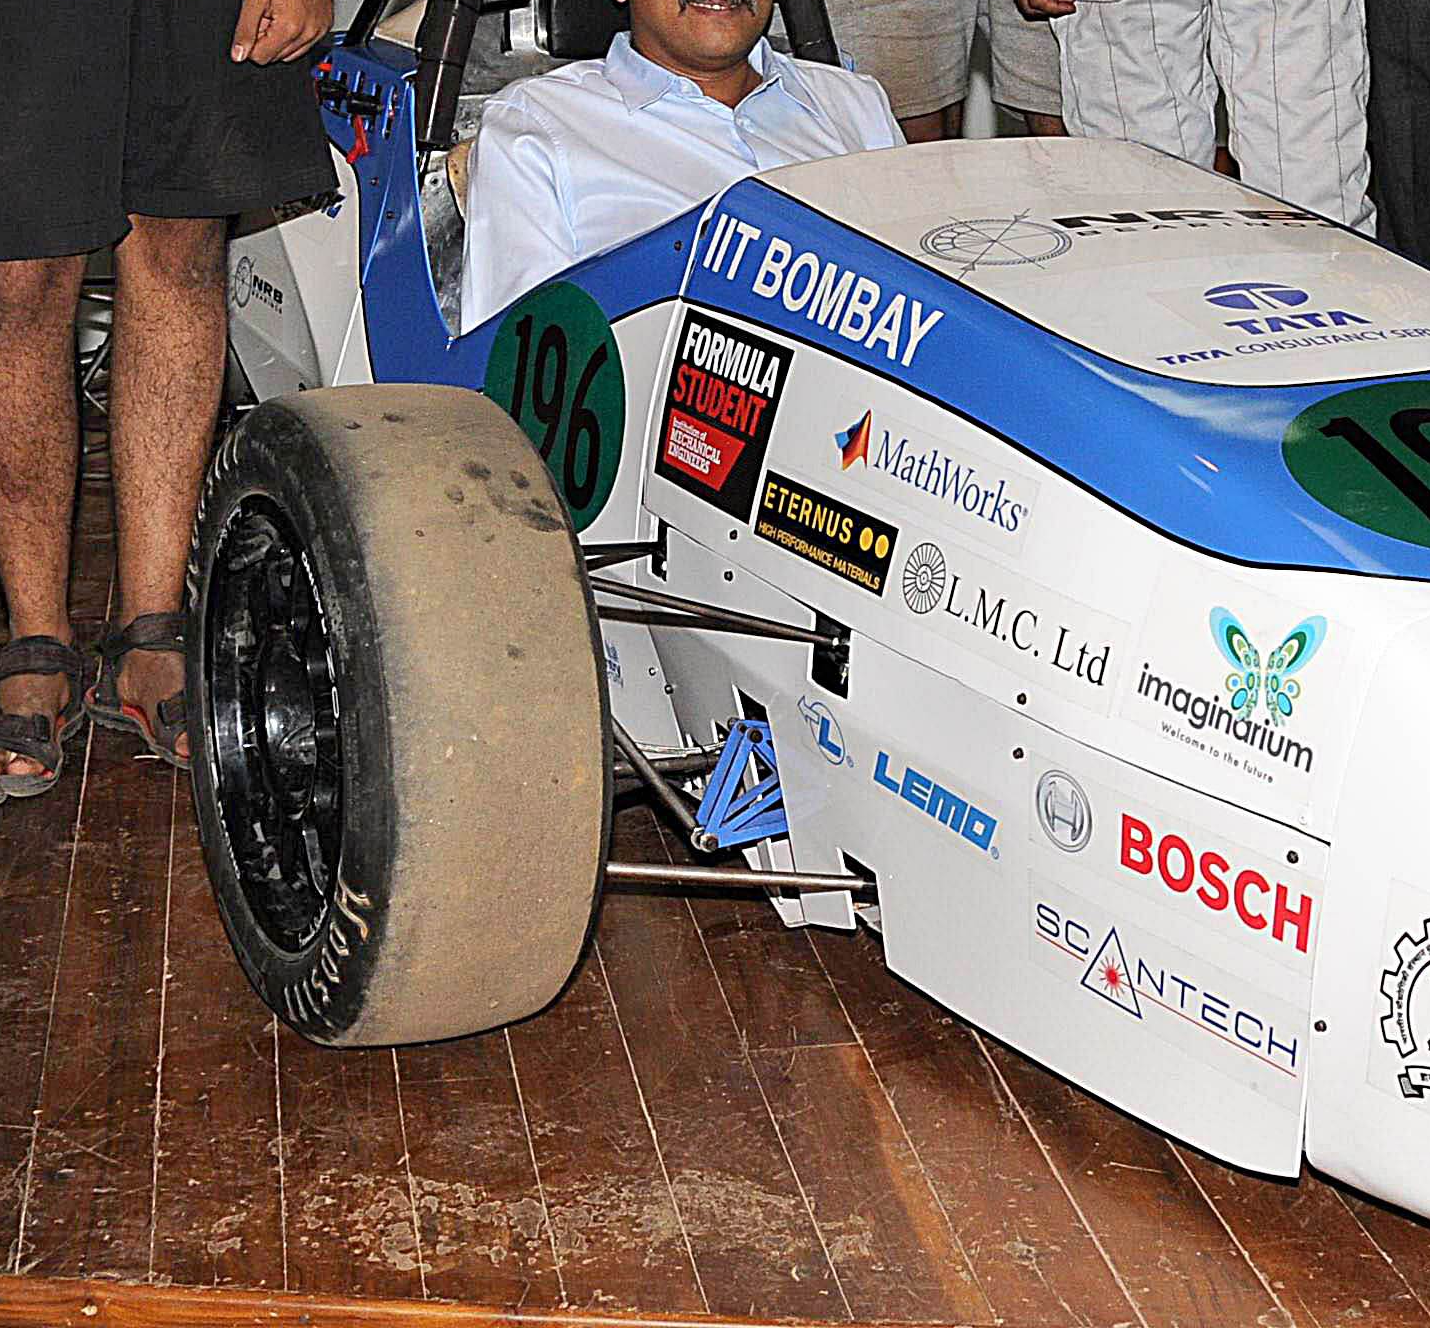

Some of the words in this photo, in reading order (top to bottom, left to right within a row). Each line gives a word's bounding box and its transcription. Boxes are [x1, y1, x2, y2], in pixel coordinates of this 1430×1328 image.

[253, 275, 283, 304] NRB
[703, 213, 757, 283] IIT
[752, 236, 944, 368] BOMBAY
[1224, 310, 1372, 335] TATA
[682, 322, 781, 398] FORMULA
[1156, 349, 1234, 365] TATA
[1235, 329, 1388, 355] CONSULTANCY
[510, 314, 608, 509] 196
[673, 364, 767, 437] STUDENT
[764, 482, 854, 544] ETERNUS
[874, 429, 1024, 533] MathWorks
[758, 521, 777, 539] HIGH
[776, 529, 834, 567] PERFORMANCE
[833, 557, 881, 590] MATERIALS
[944, 576, 1039, 659] L.M.C.
[1051, 627, 1112, 687] Ltd
[1137, 663, 1313, 773] imaginarium
[1161, 721, 1205, 752] Welcome
[1209, 746, 1221, 758] to
[1223, 752, 1239, 767] the
[1243, 759, 1274, 784] future
[873, 751, 998, 852] LEMO
[1120, 813, 1314, 954] BOSCH
